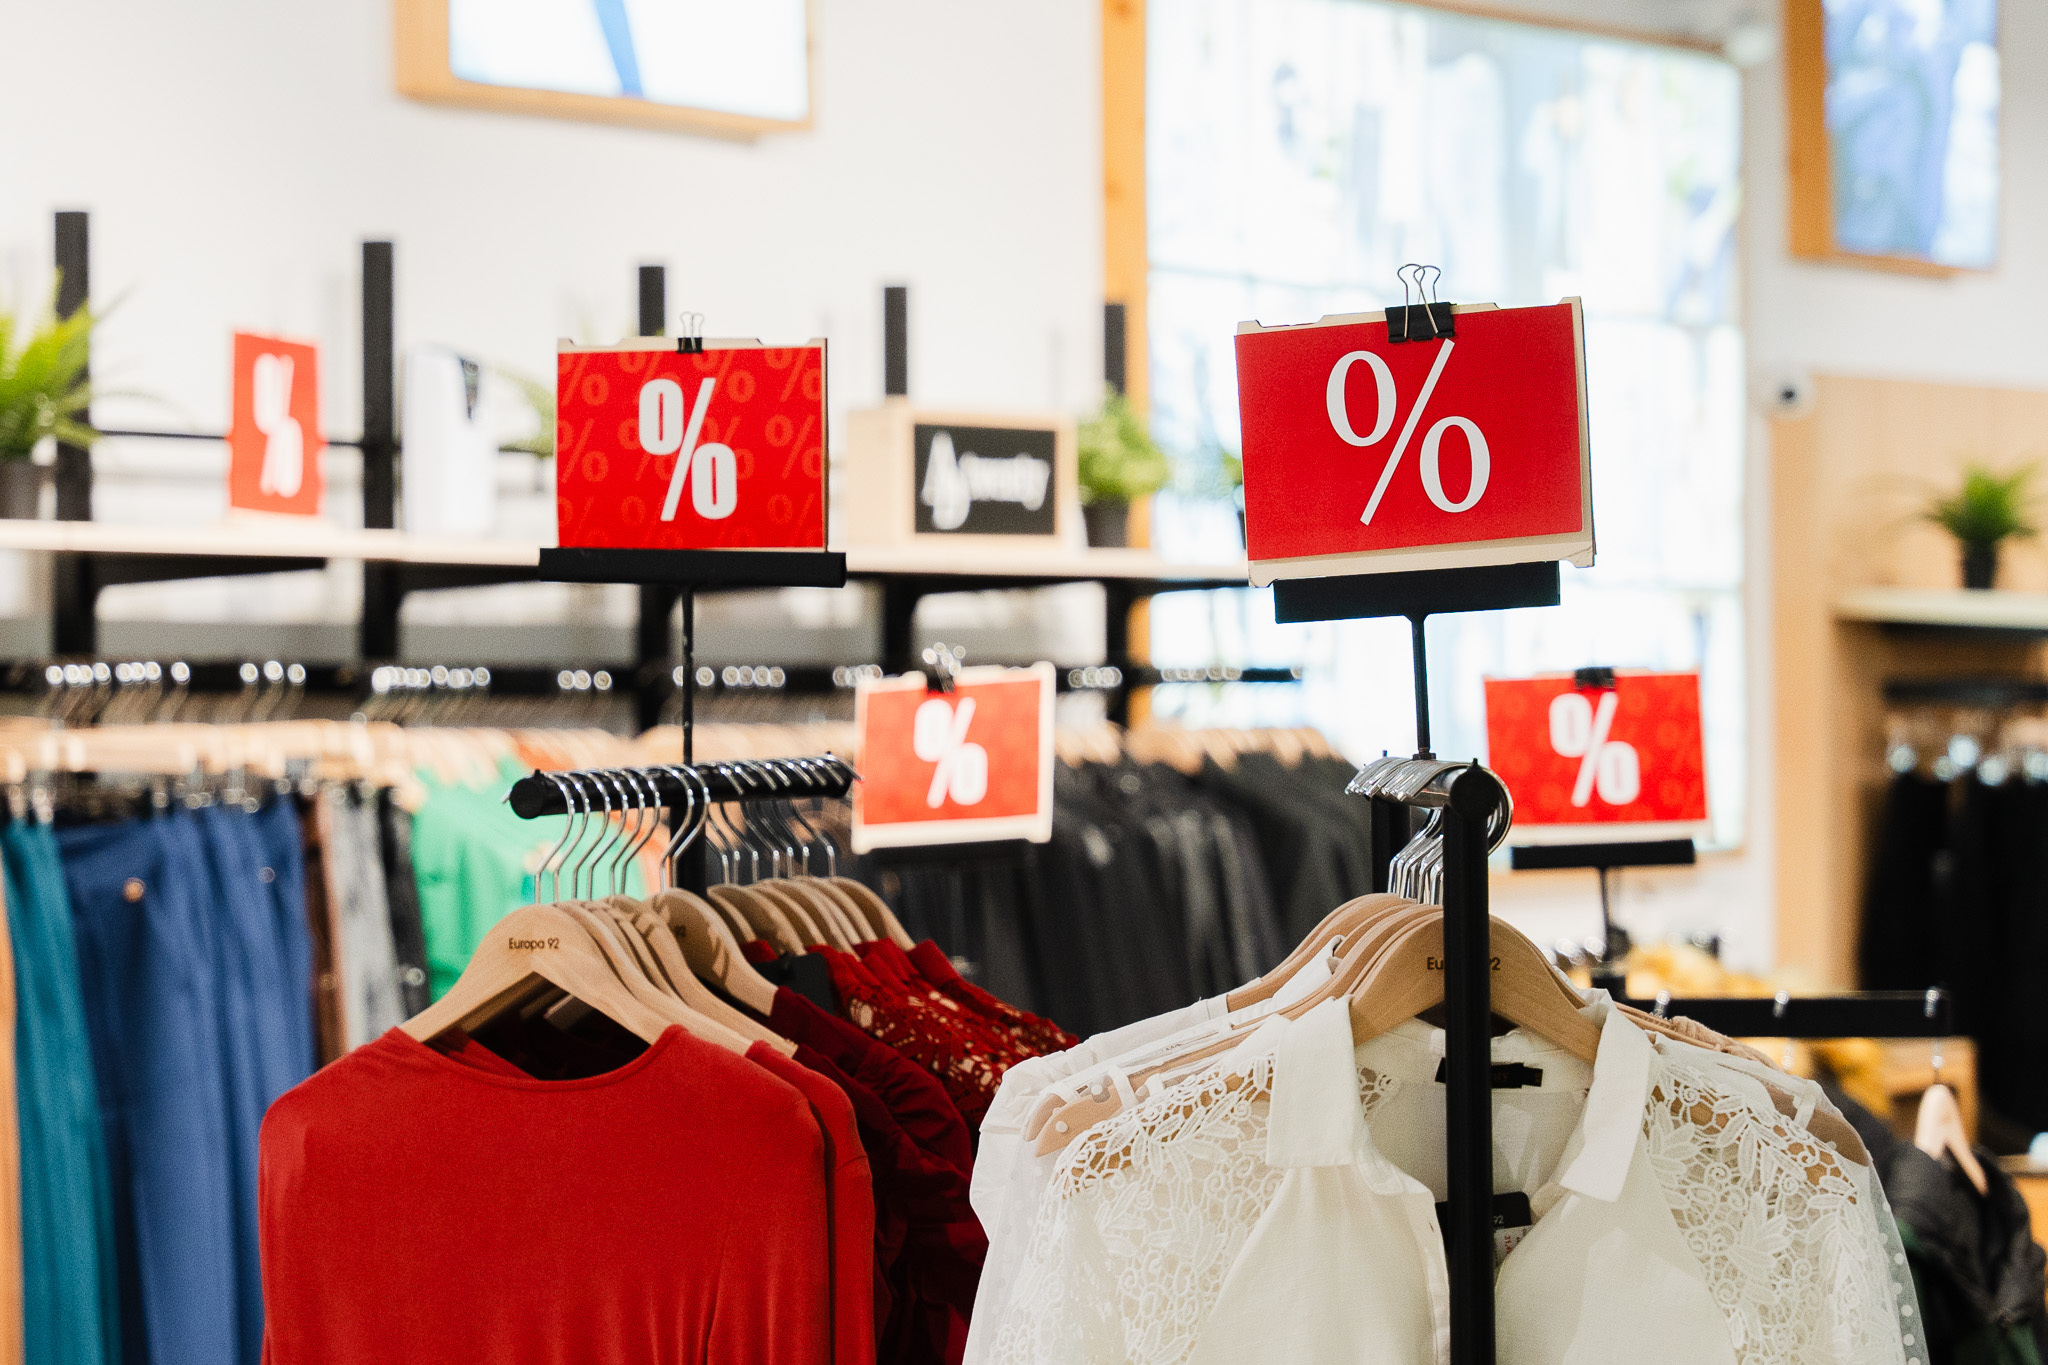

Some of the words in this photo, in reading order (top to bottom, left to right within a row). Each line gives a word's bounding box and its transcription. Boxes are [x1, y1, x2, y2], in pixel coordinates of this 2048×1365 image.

[638, 377, 738, 522] %
[1326, 338, 1490, 526] %
[913, 696, 988, 809] %
[1548, 690, 1640, 808] %
[508, 937, 545, 951] Europa
[547, 937, 559, 949] 92
